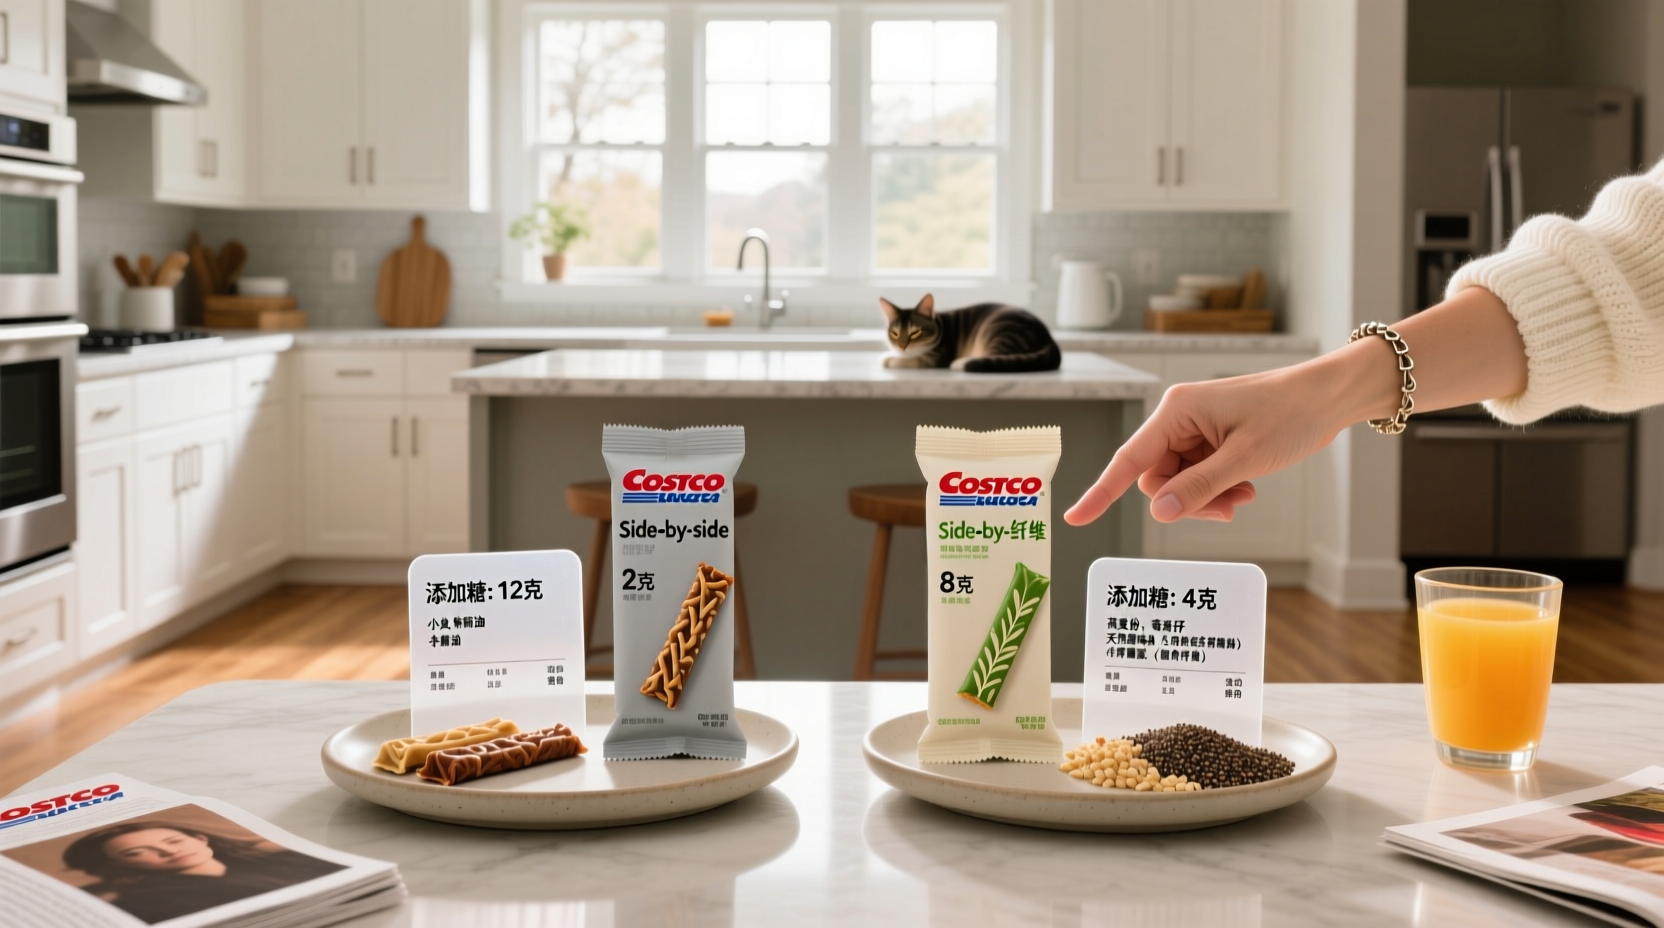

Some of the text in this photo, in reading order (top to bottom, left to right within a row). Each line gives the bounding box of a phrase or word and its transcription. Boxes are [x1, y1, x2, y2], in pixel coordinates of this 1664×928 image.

[622, 468, 725, 492] COSTCO
[939, 471, 1043, 495] COSTCO
[619, 519, 729, 543] Side-by-side
[938, 519, 1046, 544] Side-by-纤维
[622, 568, 655, 591] 2克
[940, 571, 974, 594] 8克
[0, 784, 120, 821] OSTCO
